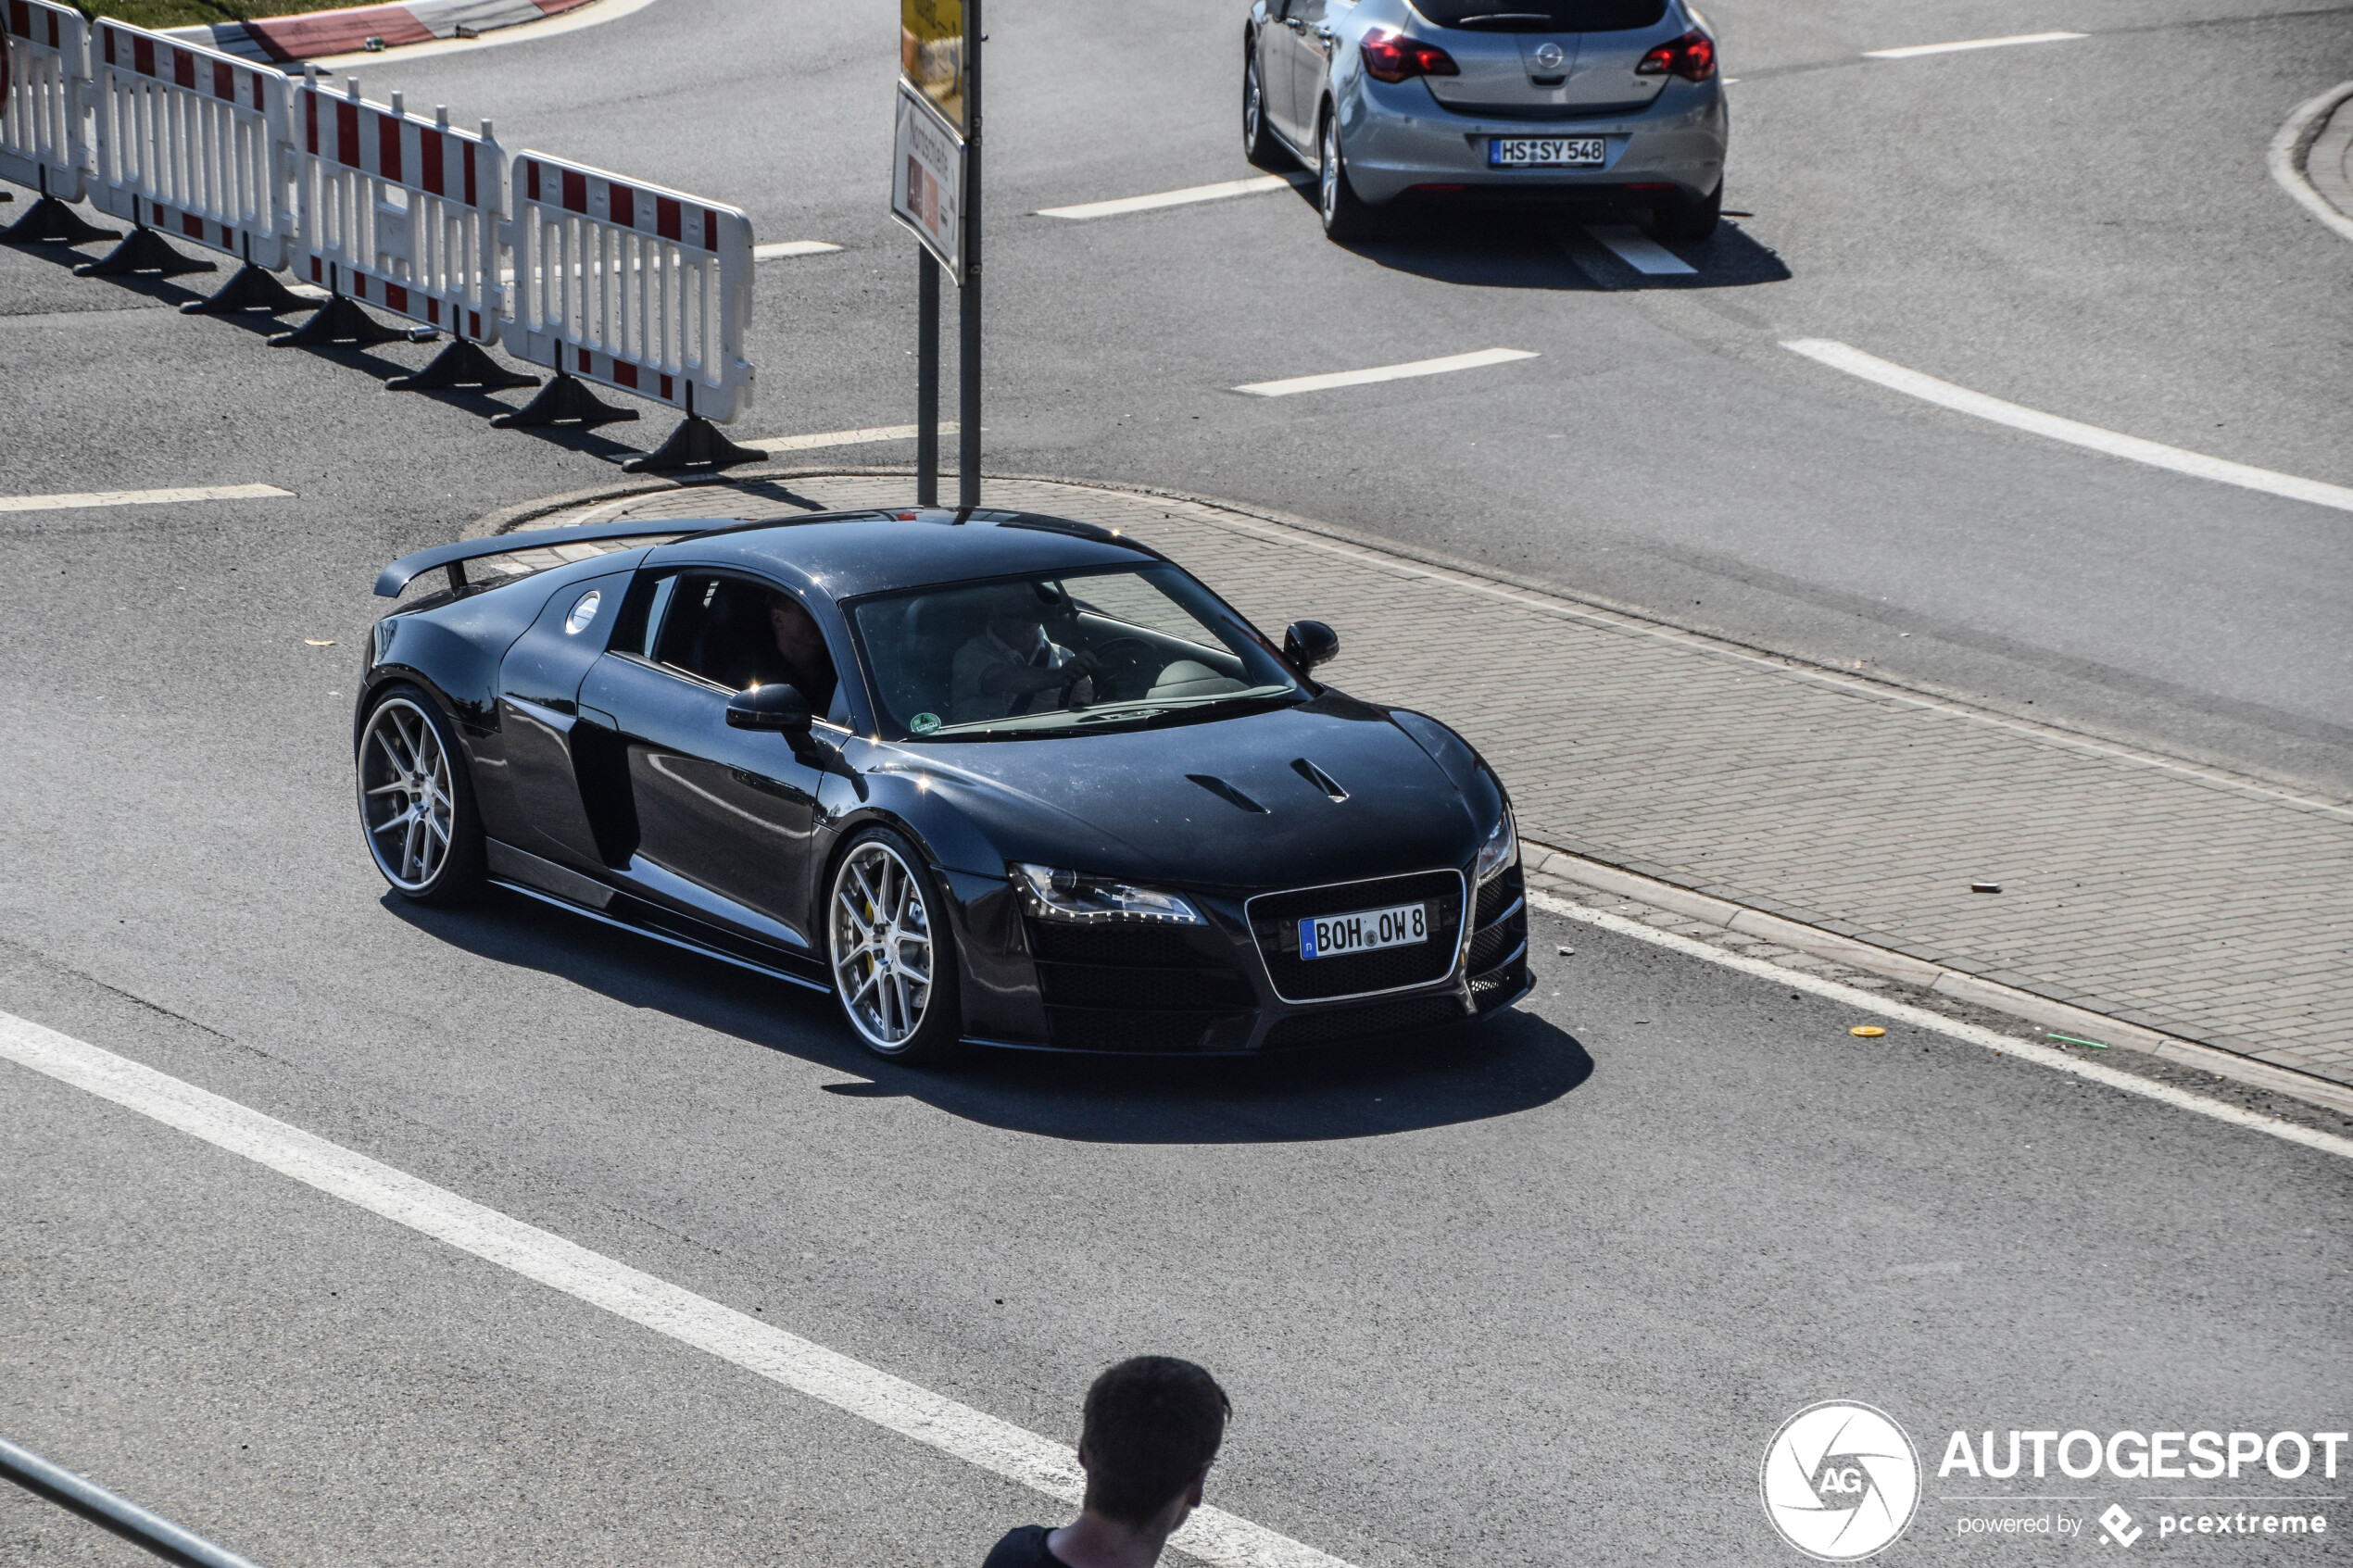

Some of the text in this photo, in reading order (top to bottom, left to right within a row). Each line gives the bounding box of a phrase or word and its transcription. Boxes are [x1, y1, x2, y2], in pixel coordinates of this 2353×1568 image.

[1503, 142, 1602, 160] HS SY 548
[1315, 909, 1424, 952] BOH OW 8
